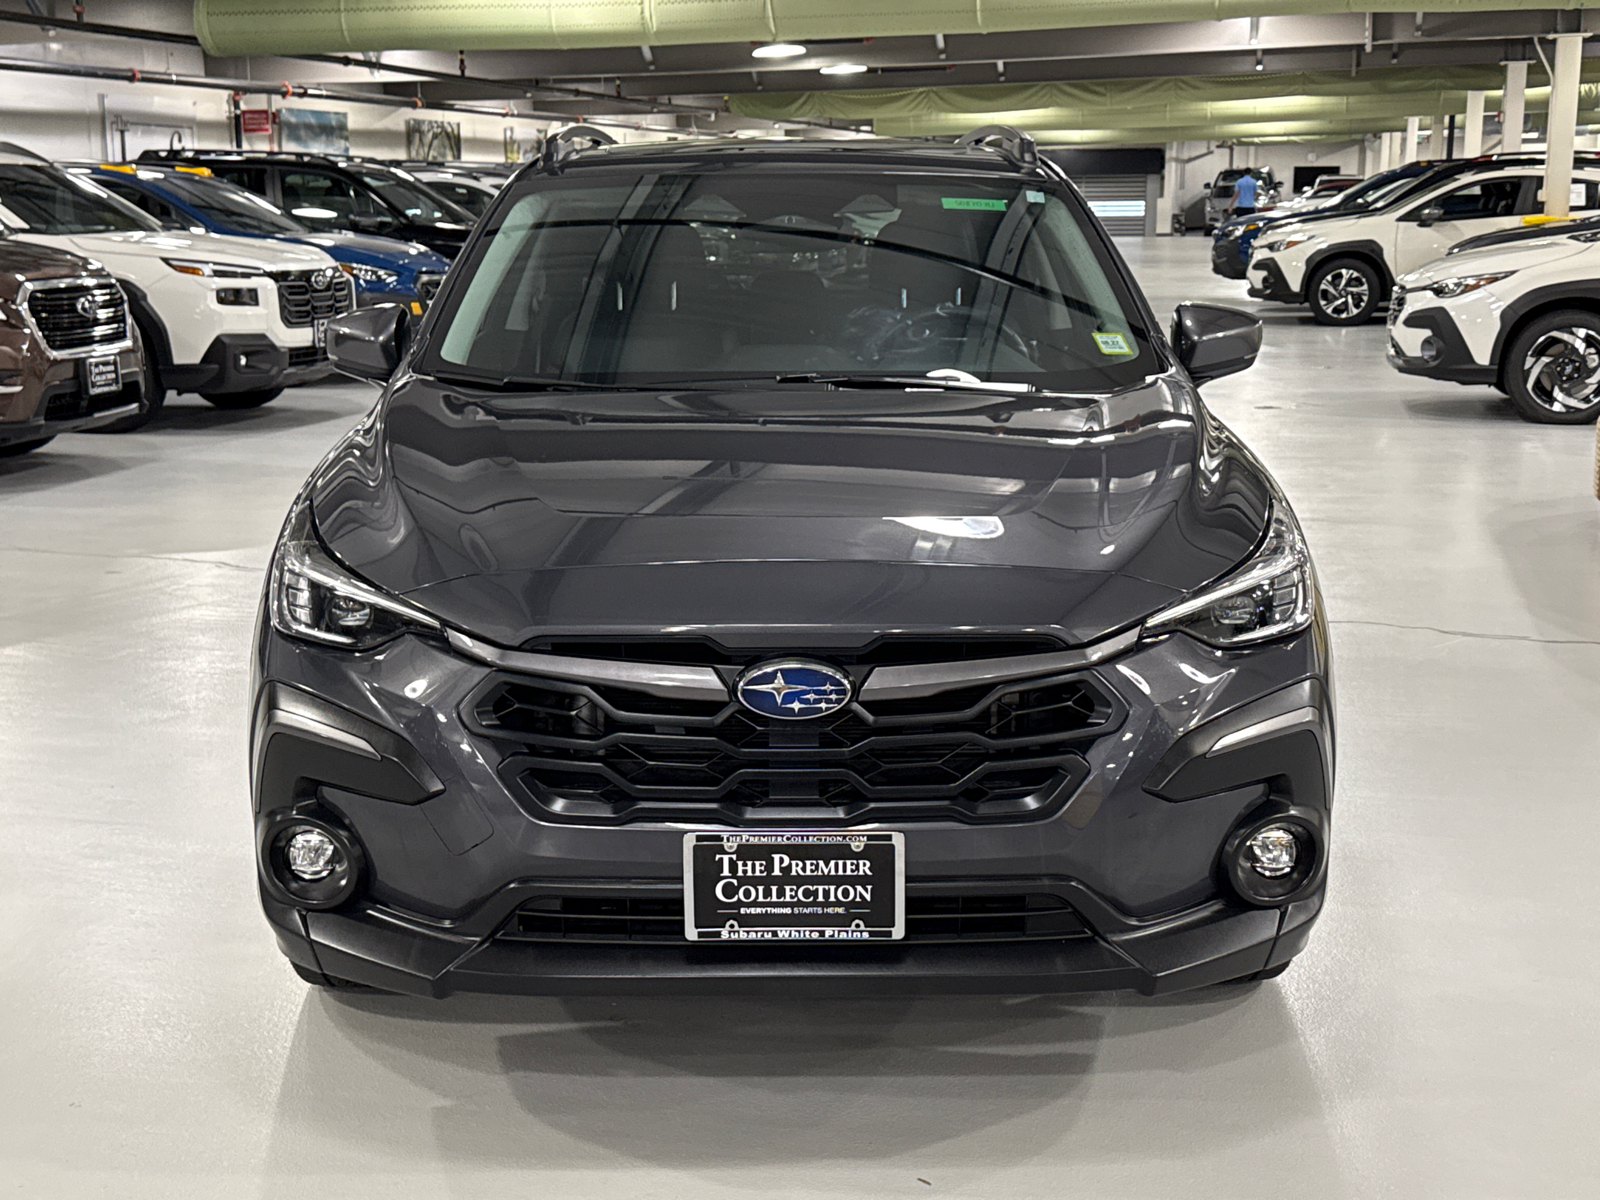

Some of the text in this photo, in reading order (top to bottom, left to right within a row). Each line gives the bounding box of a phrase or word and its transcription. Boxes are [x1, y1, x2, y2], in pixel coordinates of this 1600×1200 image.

[715, 853, 873, 877] THE PREMIER
[715, 878, 873, 902] COLLECTION
[720, 930, 870, 939] Subaru White Plains
